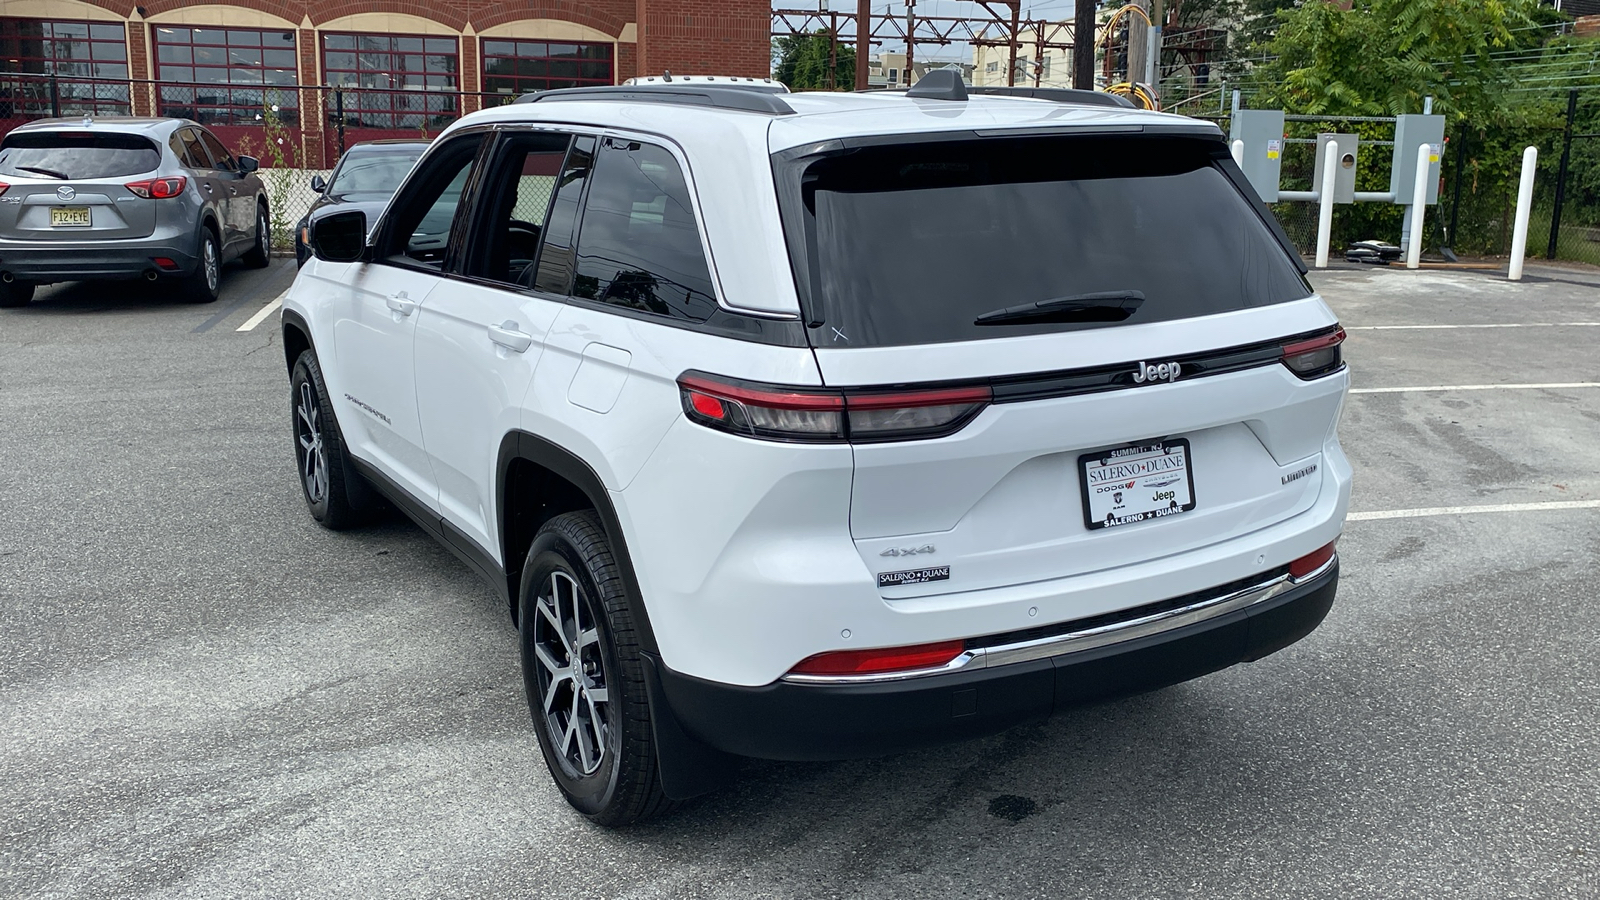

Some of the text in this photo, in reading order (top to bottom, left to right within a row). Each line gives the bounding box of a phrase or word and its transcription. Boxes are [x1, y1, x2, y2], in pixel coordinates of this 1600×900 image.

[1132, 361, 1181, 383] Jeep
[1151, 443, 1163, 452] NJ
[1090, 455, 1184, 483] SALERNO DUANE
[1152, 490, 1175, 501] Jeep
[1104, 506, 1184, 527] SALERNO DUANE
[880, 568, 949, 583] SALERNO DUANE
